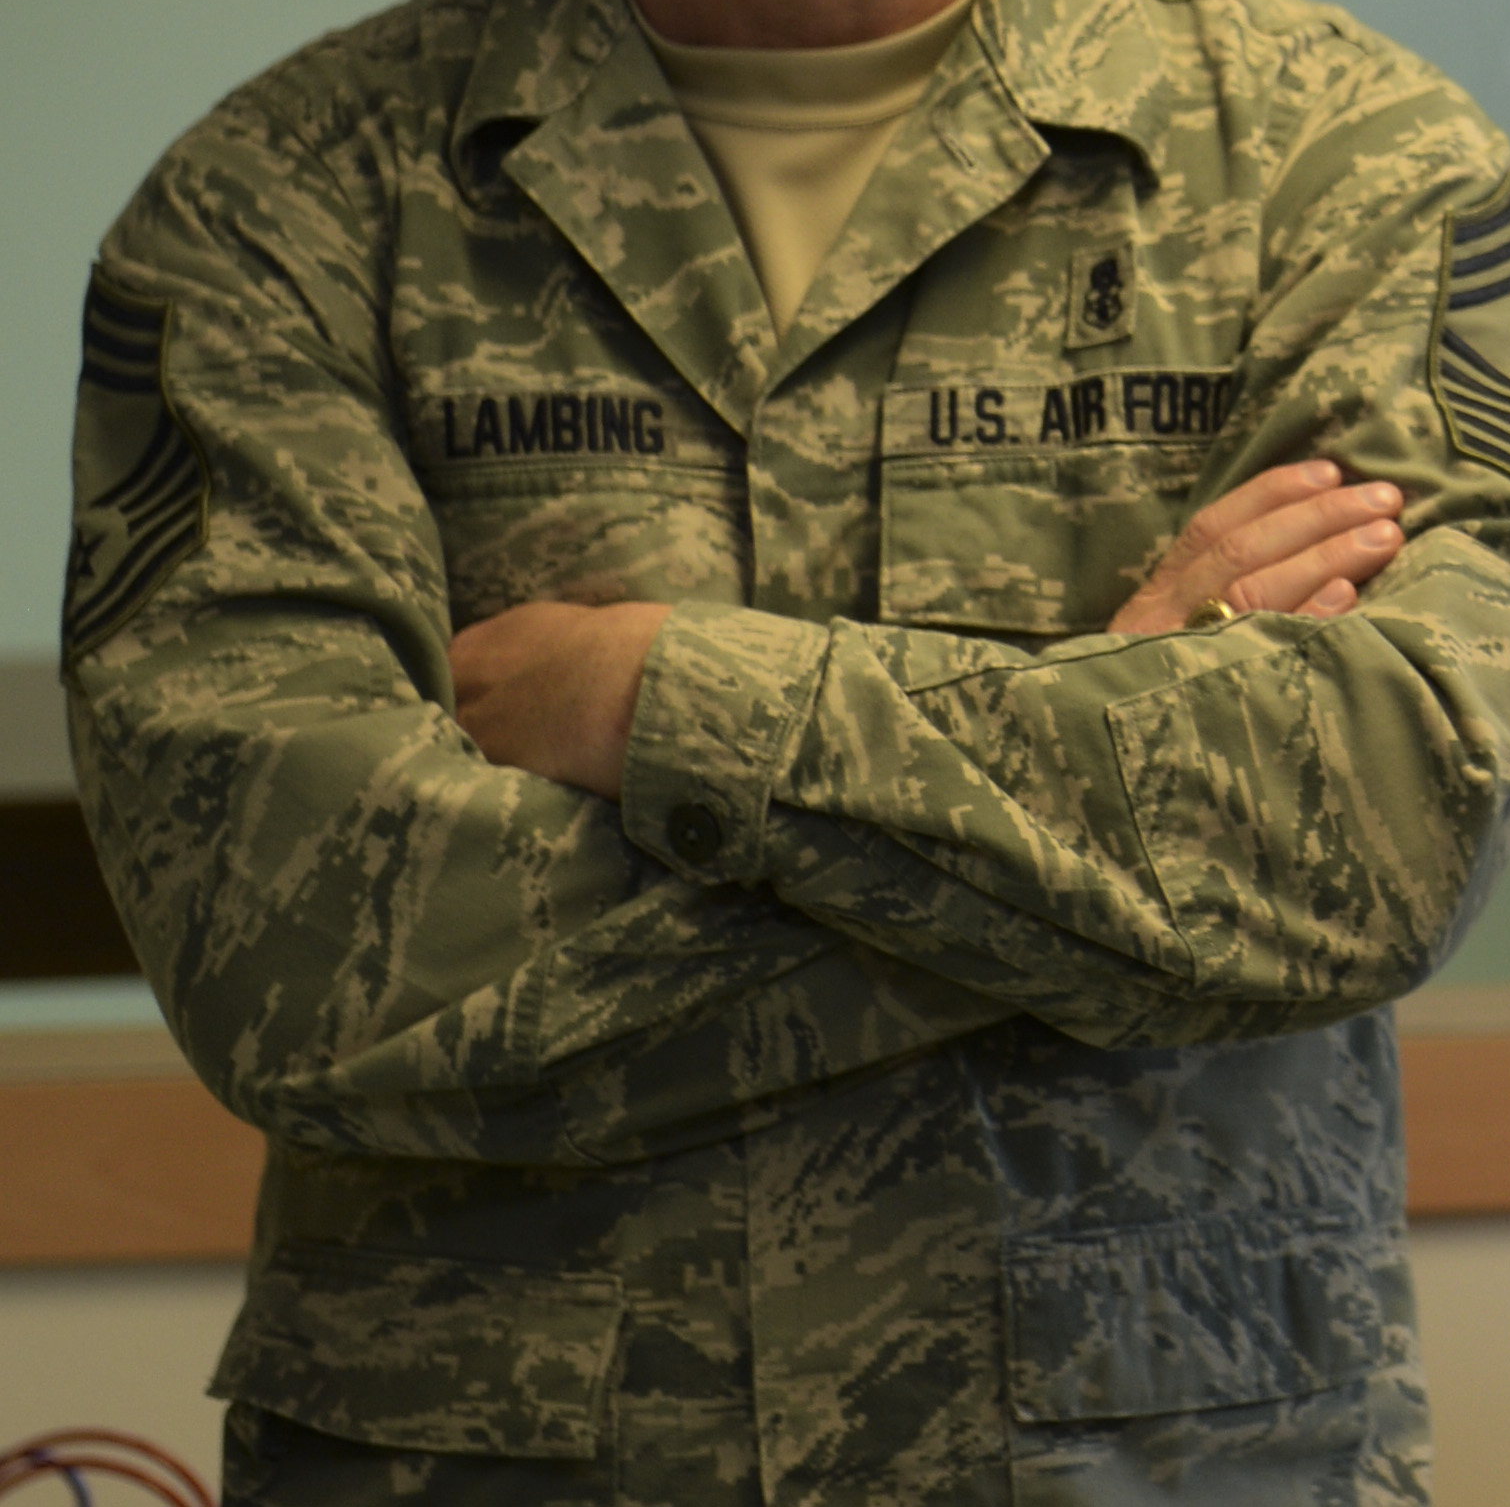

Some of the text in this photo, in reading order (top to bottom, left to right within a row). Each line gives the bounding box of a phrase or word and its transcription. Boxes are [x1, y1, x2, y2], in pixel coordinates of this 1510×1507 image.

[443, 393, 665, 460] LAMBING
[929, 372, 1233, 447] U.S. AIR FORC
